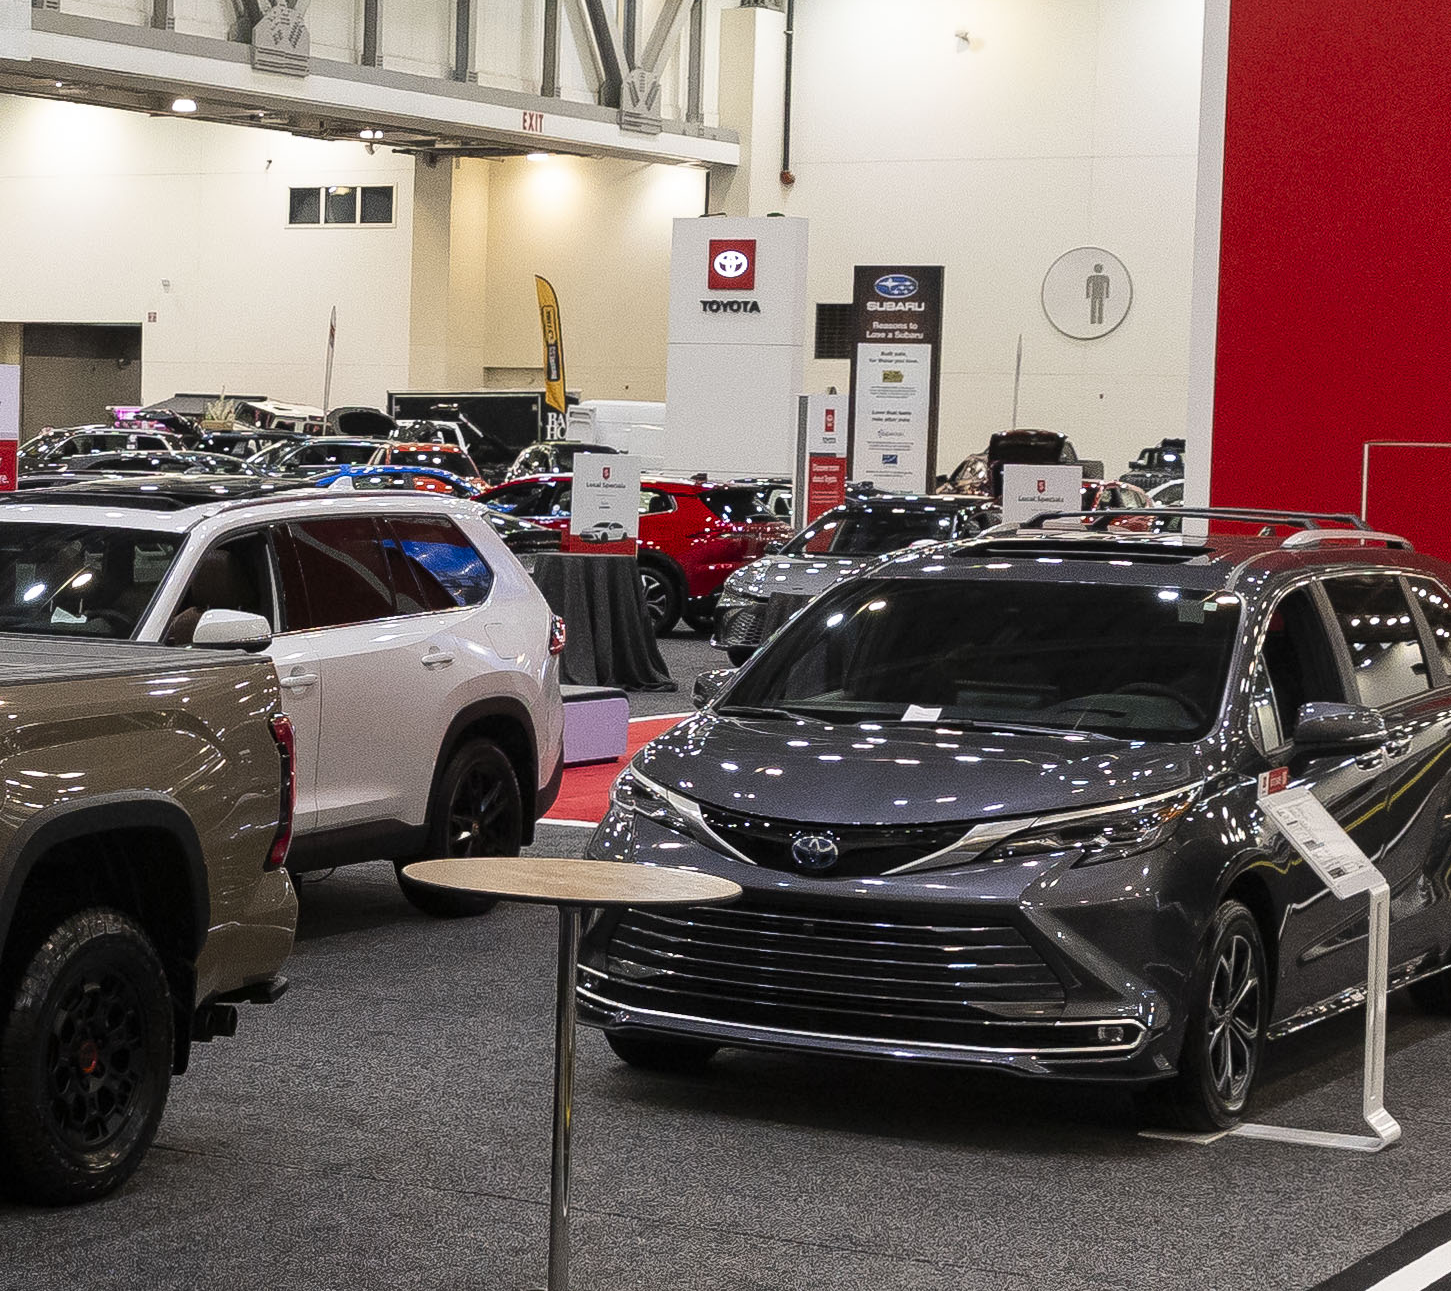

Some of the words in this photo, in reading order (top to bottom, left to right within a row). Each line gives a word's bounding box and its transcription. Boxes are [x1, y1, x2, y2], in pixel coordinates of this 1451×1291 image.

[522, 111, 544, 133] EXIT
[699, 299, 761, 314] TOYOTA
[866, 301, 925, 312] SUBARU
